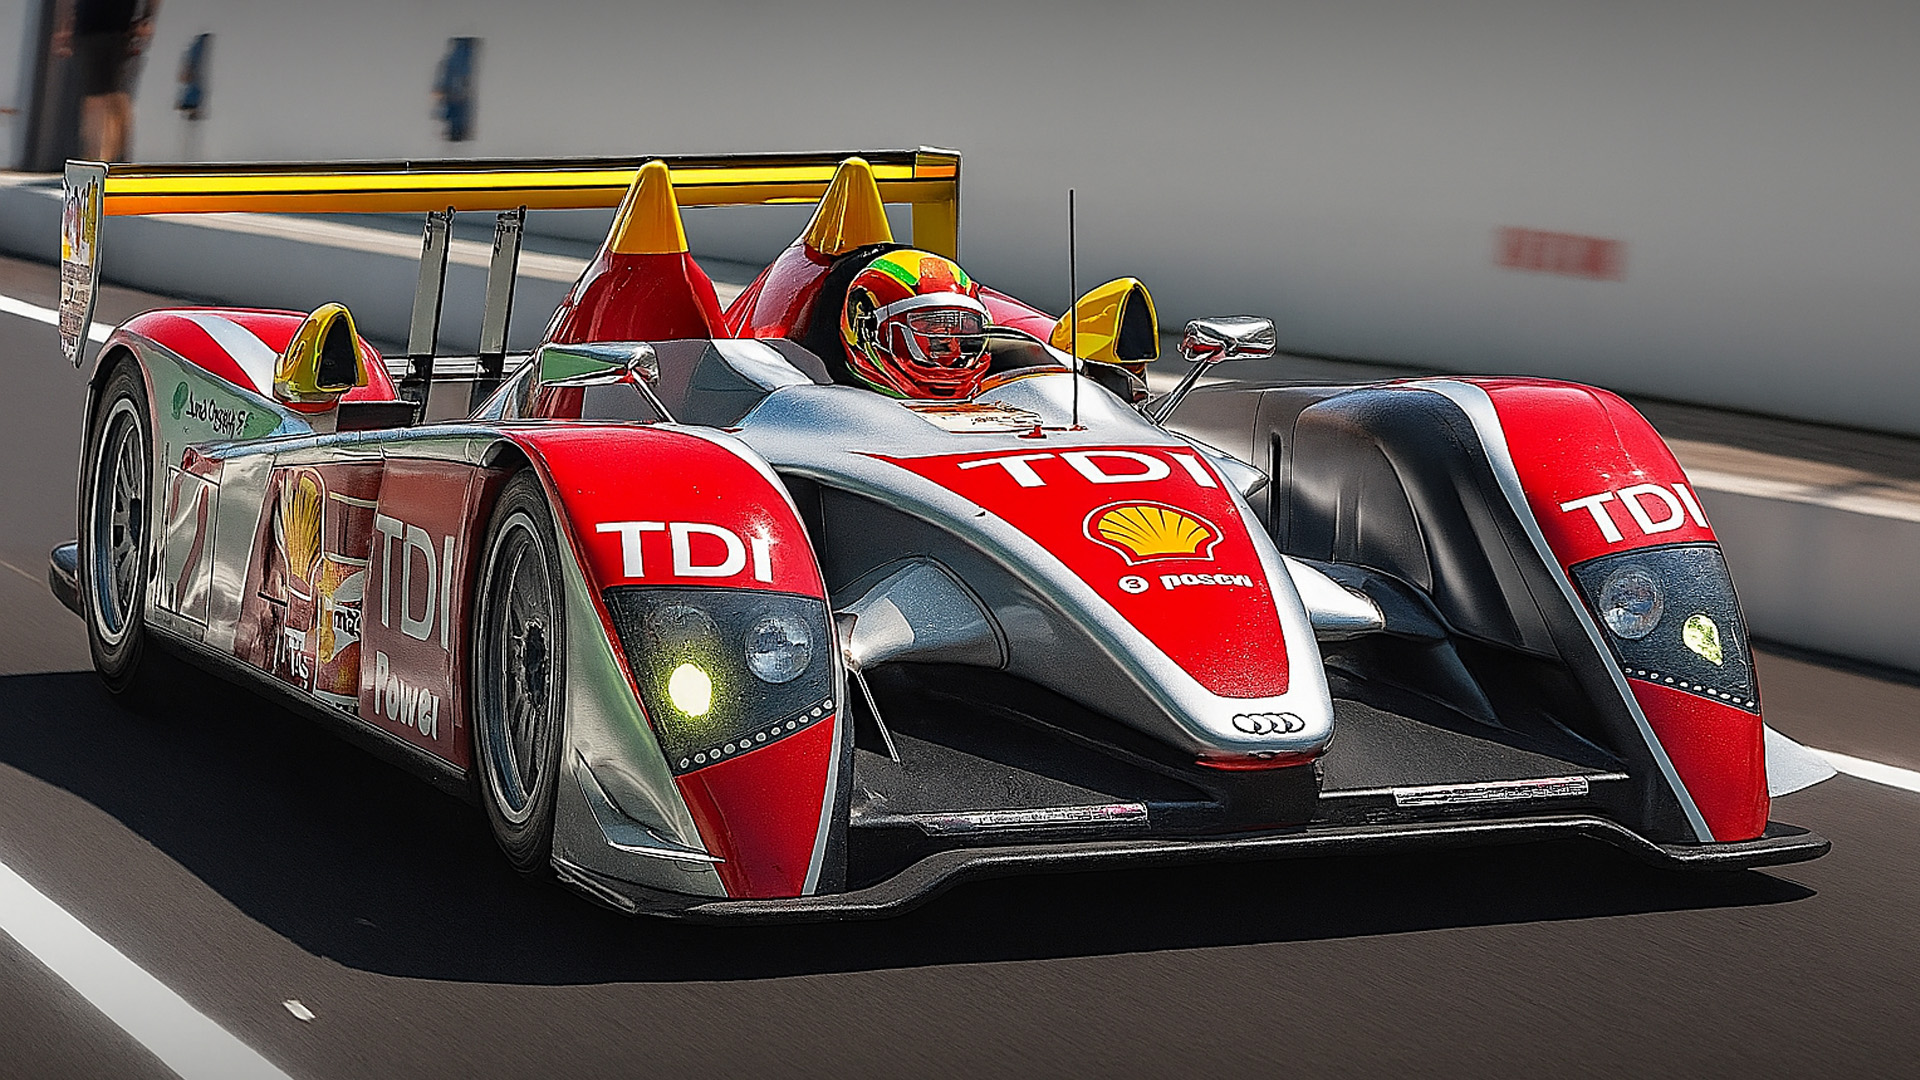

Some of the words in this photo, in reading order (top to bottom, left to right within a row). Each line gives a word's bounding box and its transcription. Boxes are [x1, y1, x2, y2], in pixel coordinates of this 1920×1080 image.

[957, 450, 1219, 488] TDI
[1559, 482, 1709, 544] TDI
[376, 513, 455, 651] TDI
[595, 521, 774, 584] TDI
[374, 650, 440, 742] Power
